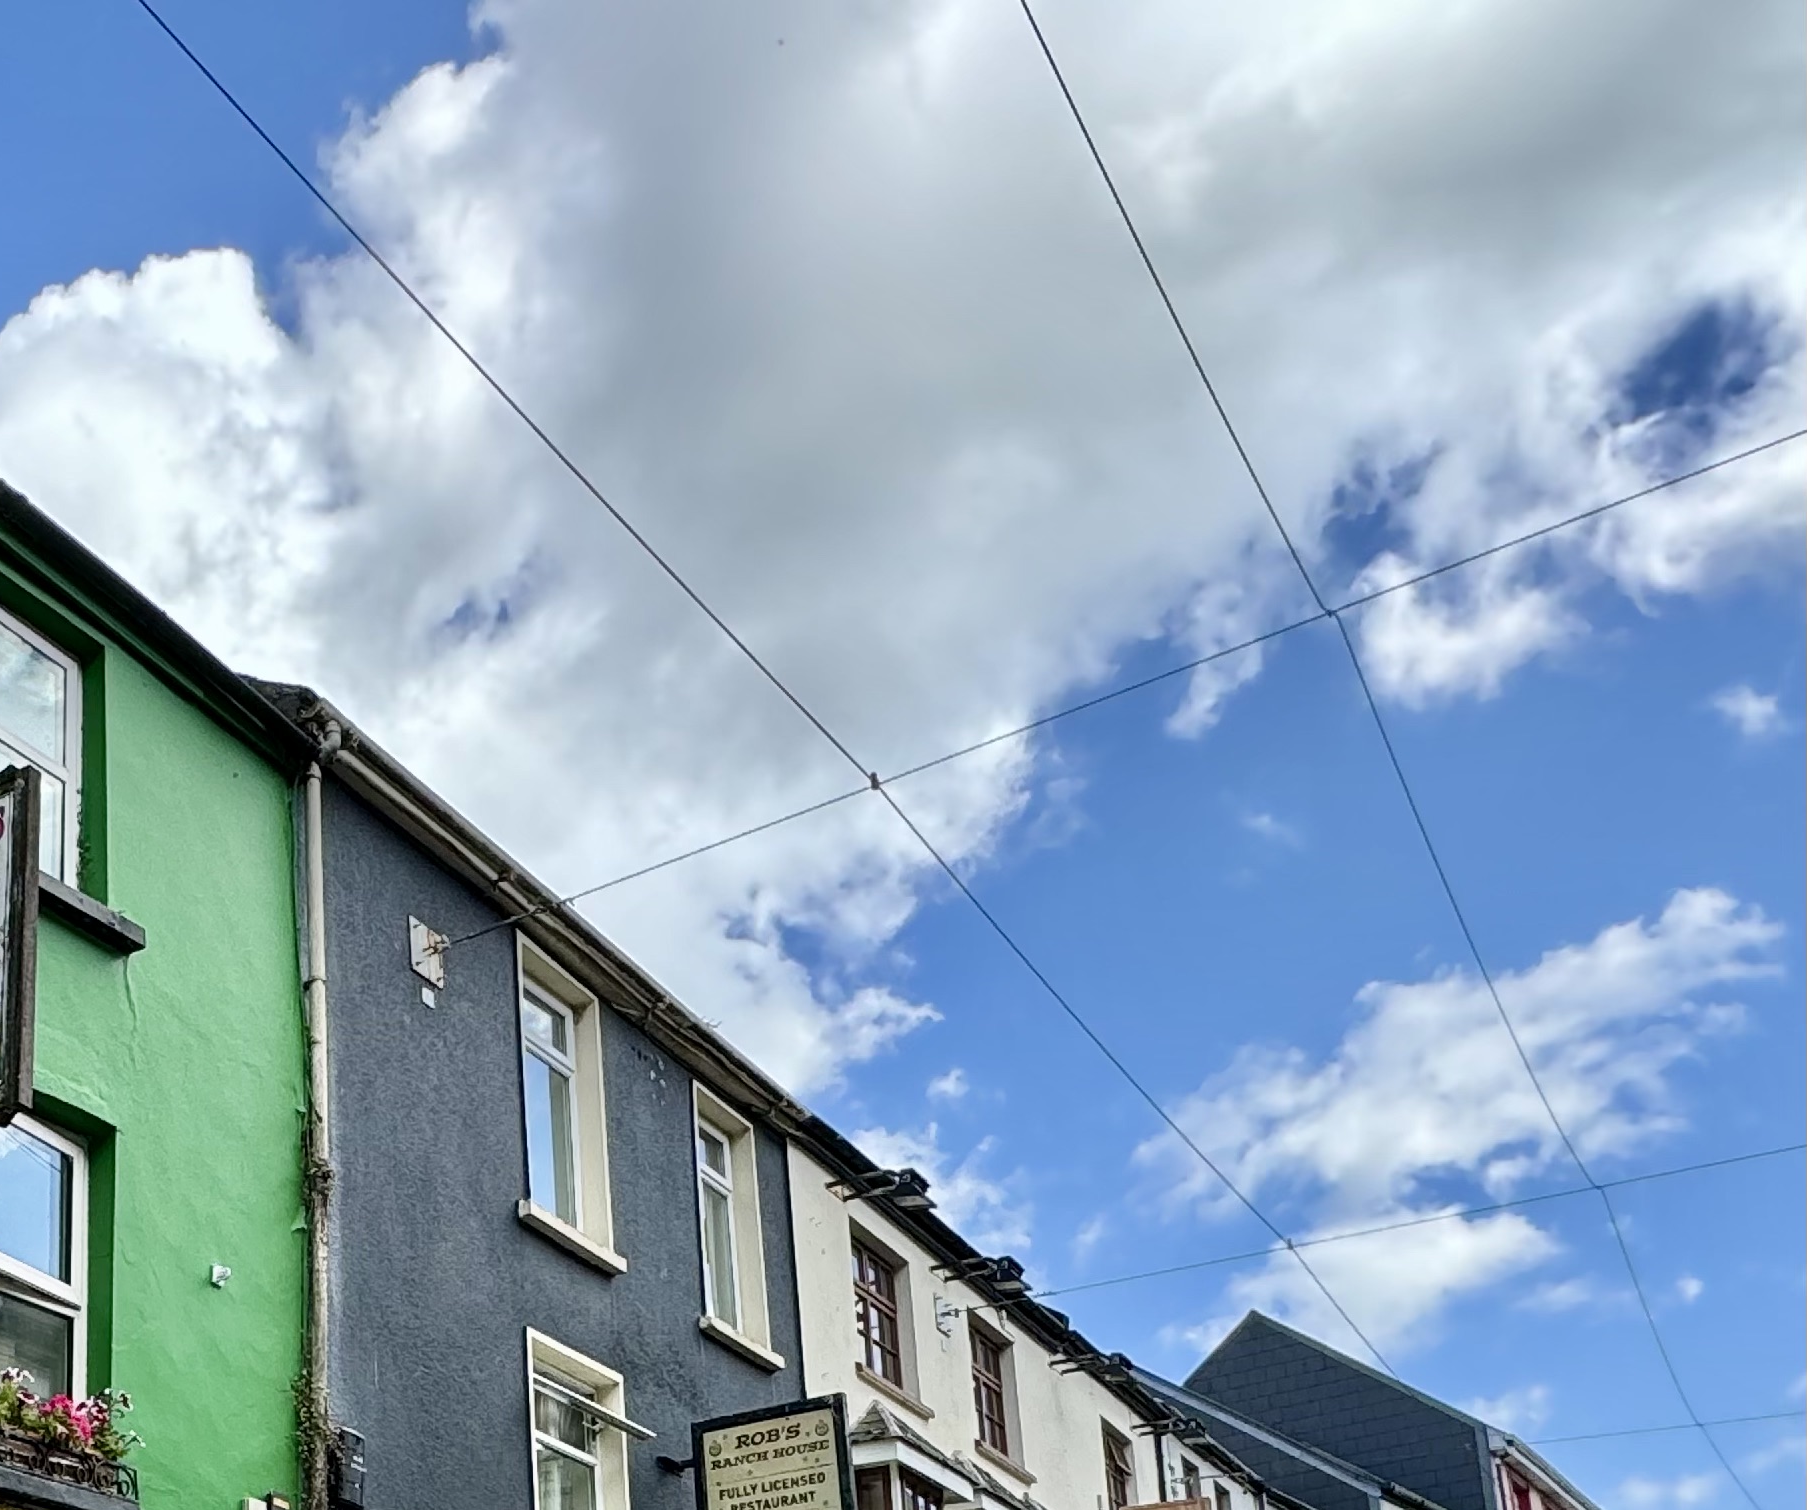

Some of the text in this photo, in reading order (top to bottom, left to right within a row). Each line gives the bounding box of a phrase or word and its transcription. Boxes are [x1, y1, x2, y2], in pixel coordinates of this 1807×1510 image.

[735, 1423, 802, 1450] ROB'S
[710, 1439, 830, 1471] RANCH HOUSE
[719, 1471, 826, 1501] FULLY LICENSED
